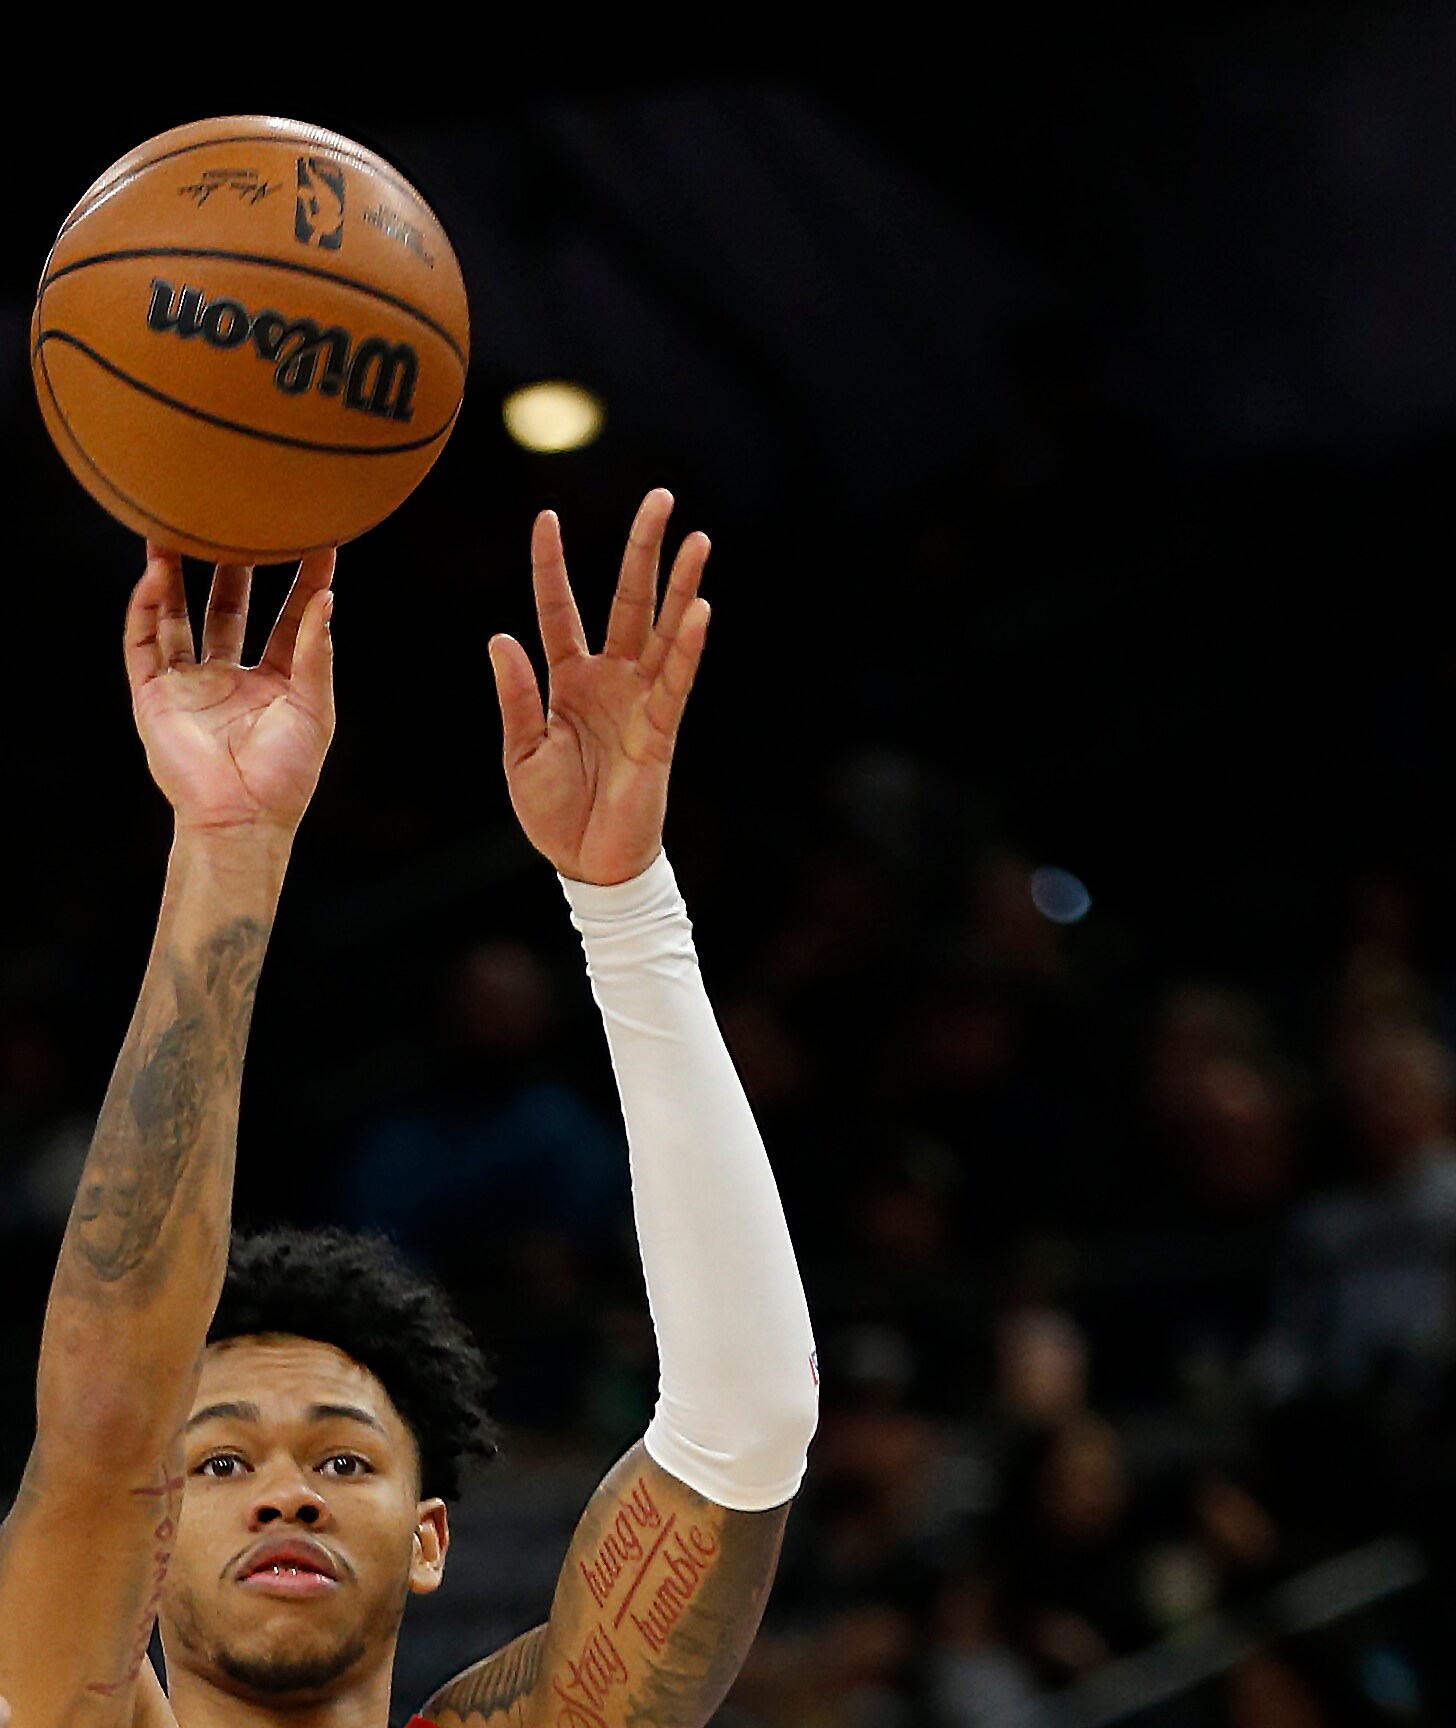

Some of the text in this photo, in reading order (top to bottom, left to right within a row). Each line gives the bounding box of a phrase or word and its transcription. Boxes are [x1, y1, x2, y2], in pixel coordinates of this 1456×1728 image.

[146, 276, 419, 424] Wilson
[579, 1477, 663, 1608] hungry
[630, 1523, 719, 1655] humble
